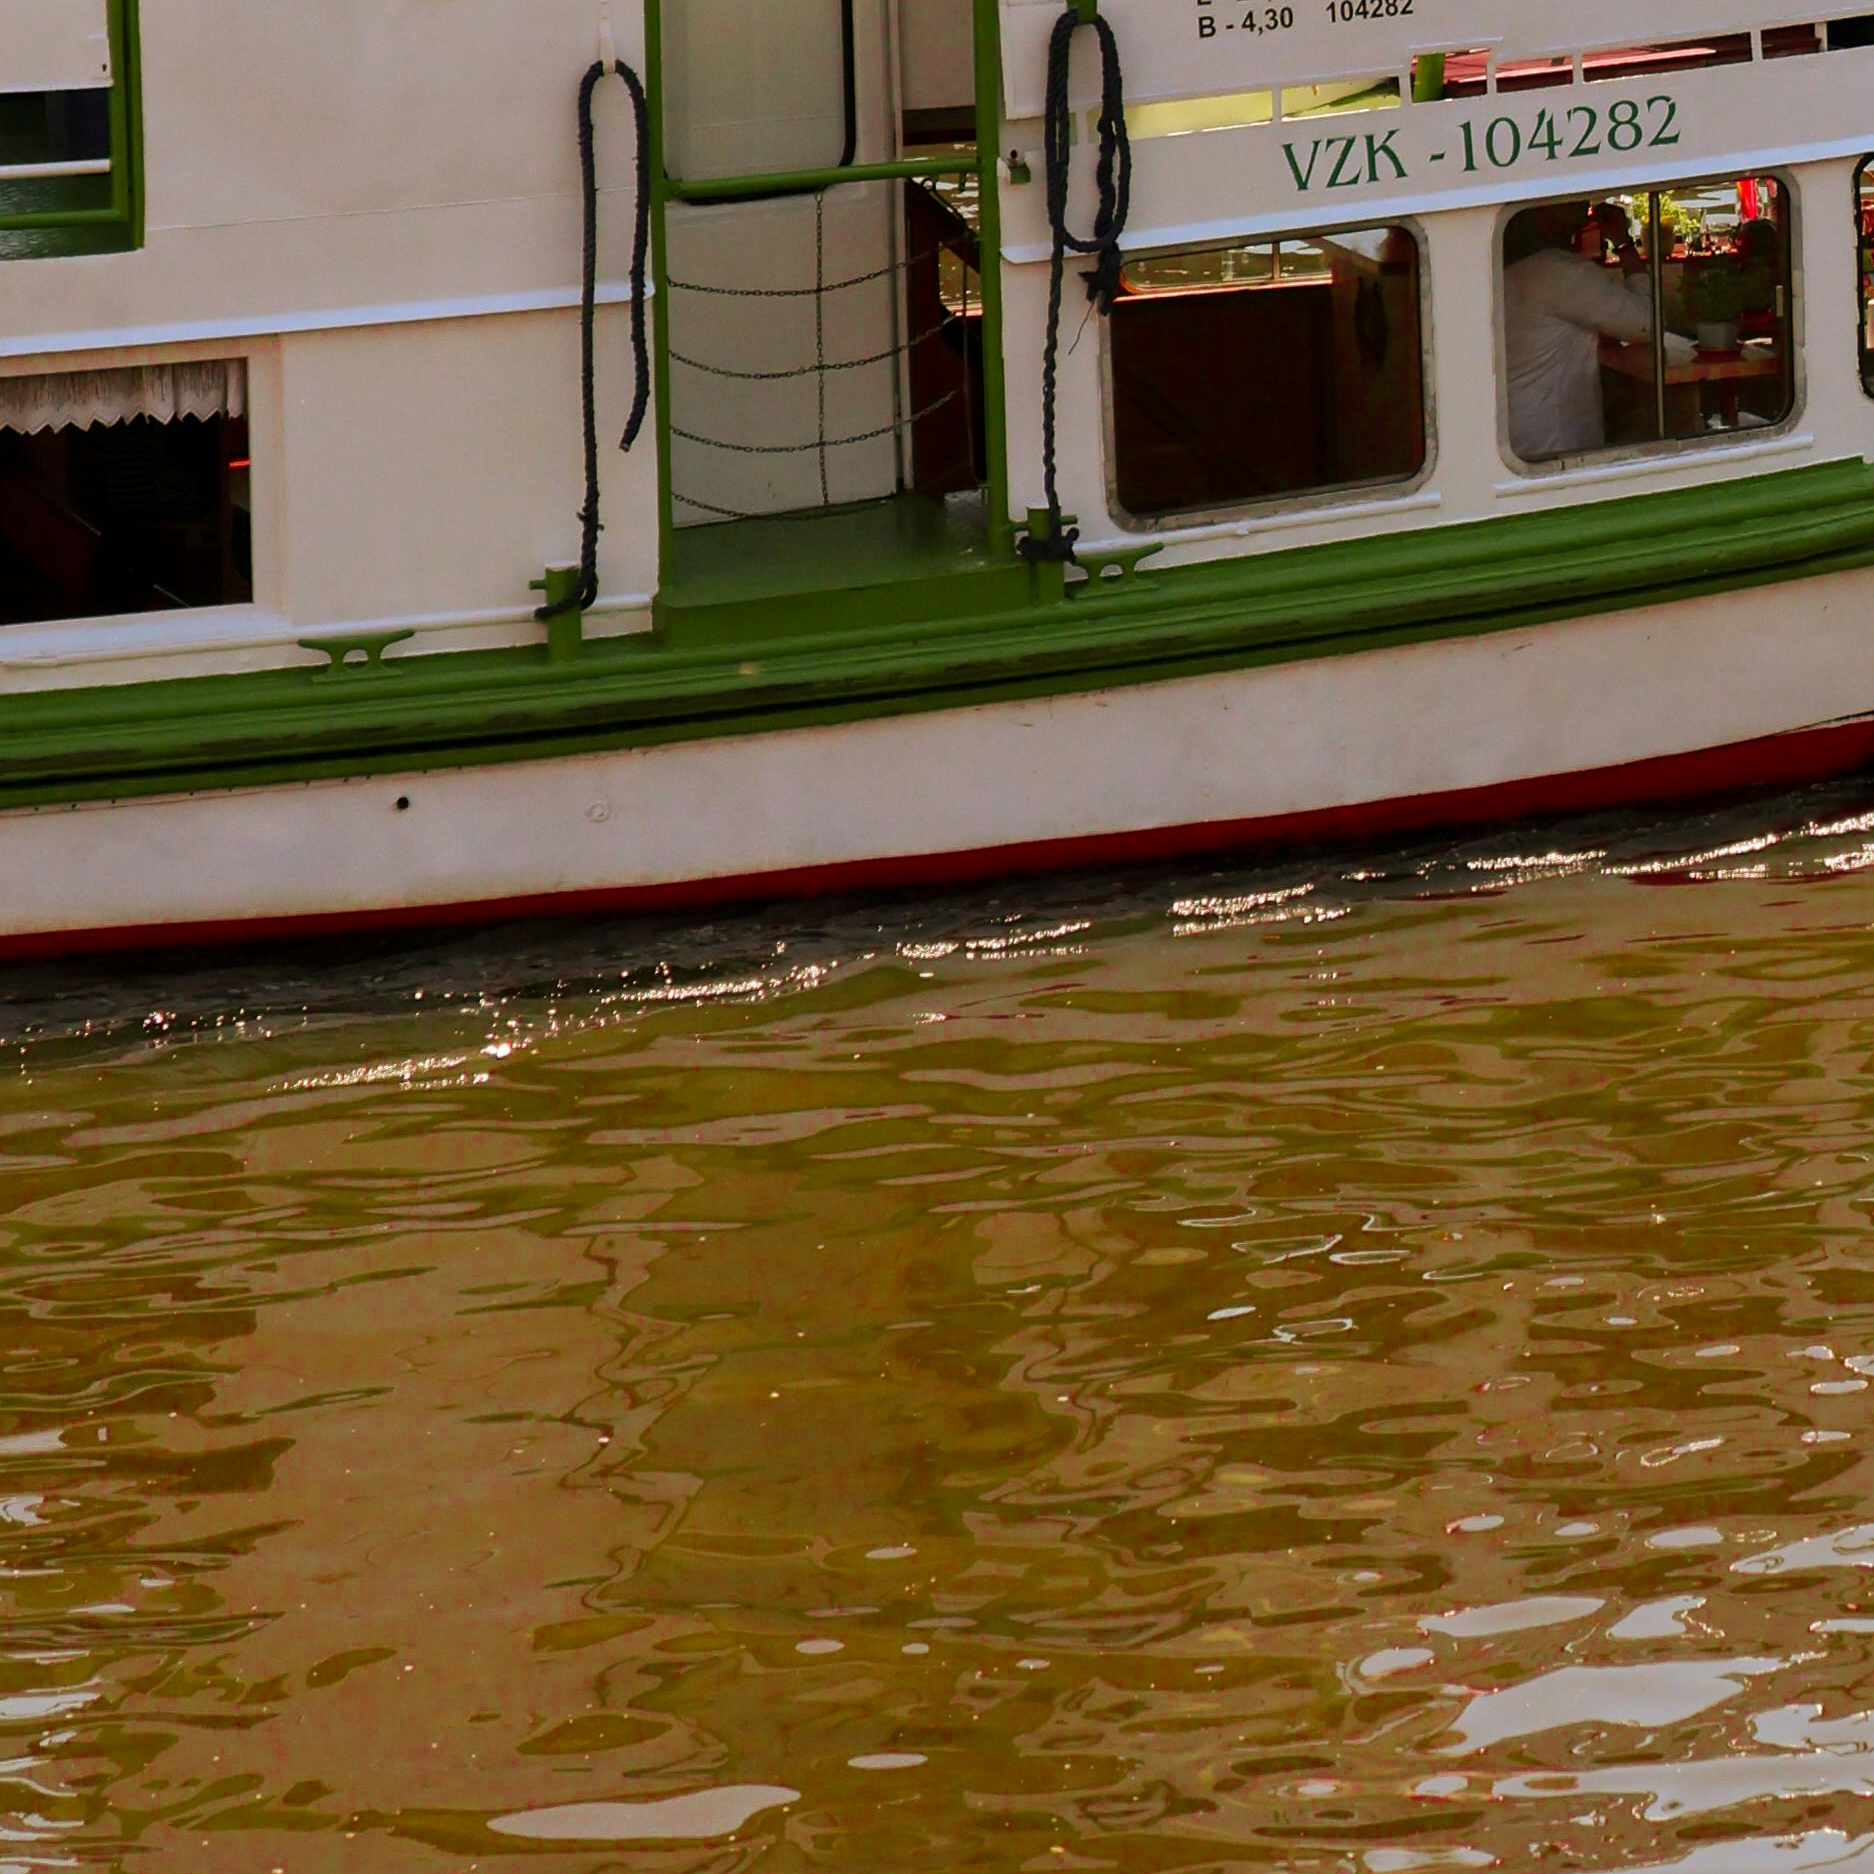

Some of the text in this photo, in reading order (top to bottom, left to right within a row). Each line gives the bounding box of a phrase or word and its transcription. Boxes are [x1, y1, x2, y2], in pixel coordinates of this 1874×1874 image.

[1197, 15, 1217, 39] B
[1241, 6, 1294, 36] 4,30
[1280, 128, 1409, 192] VZK
